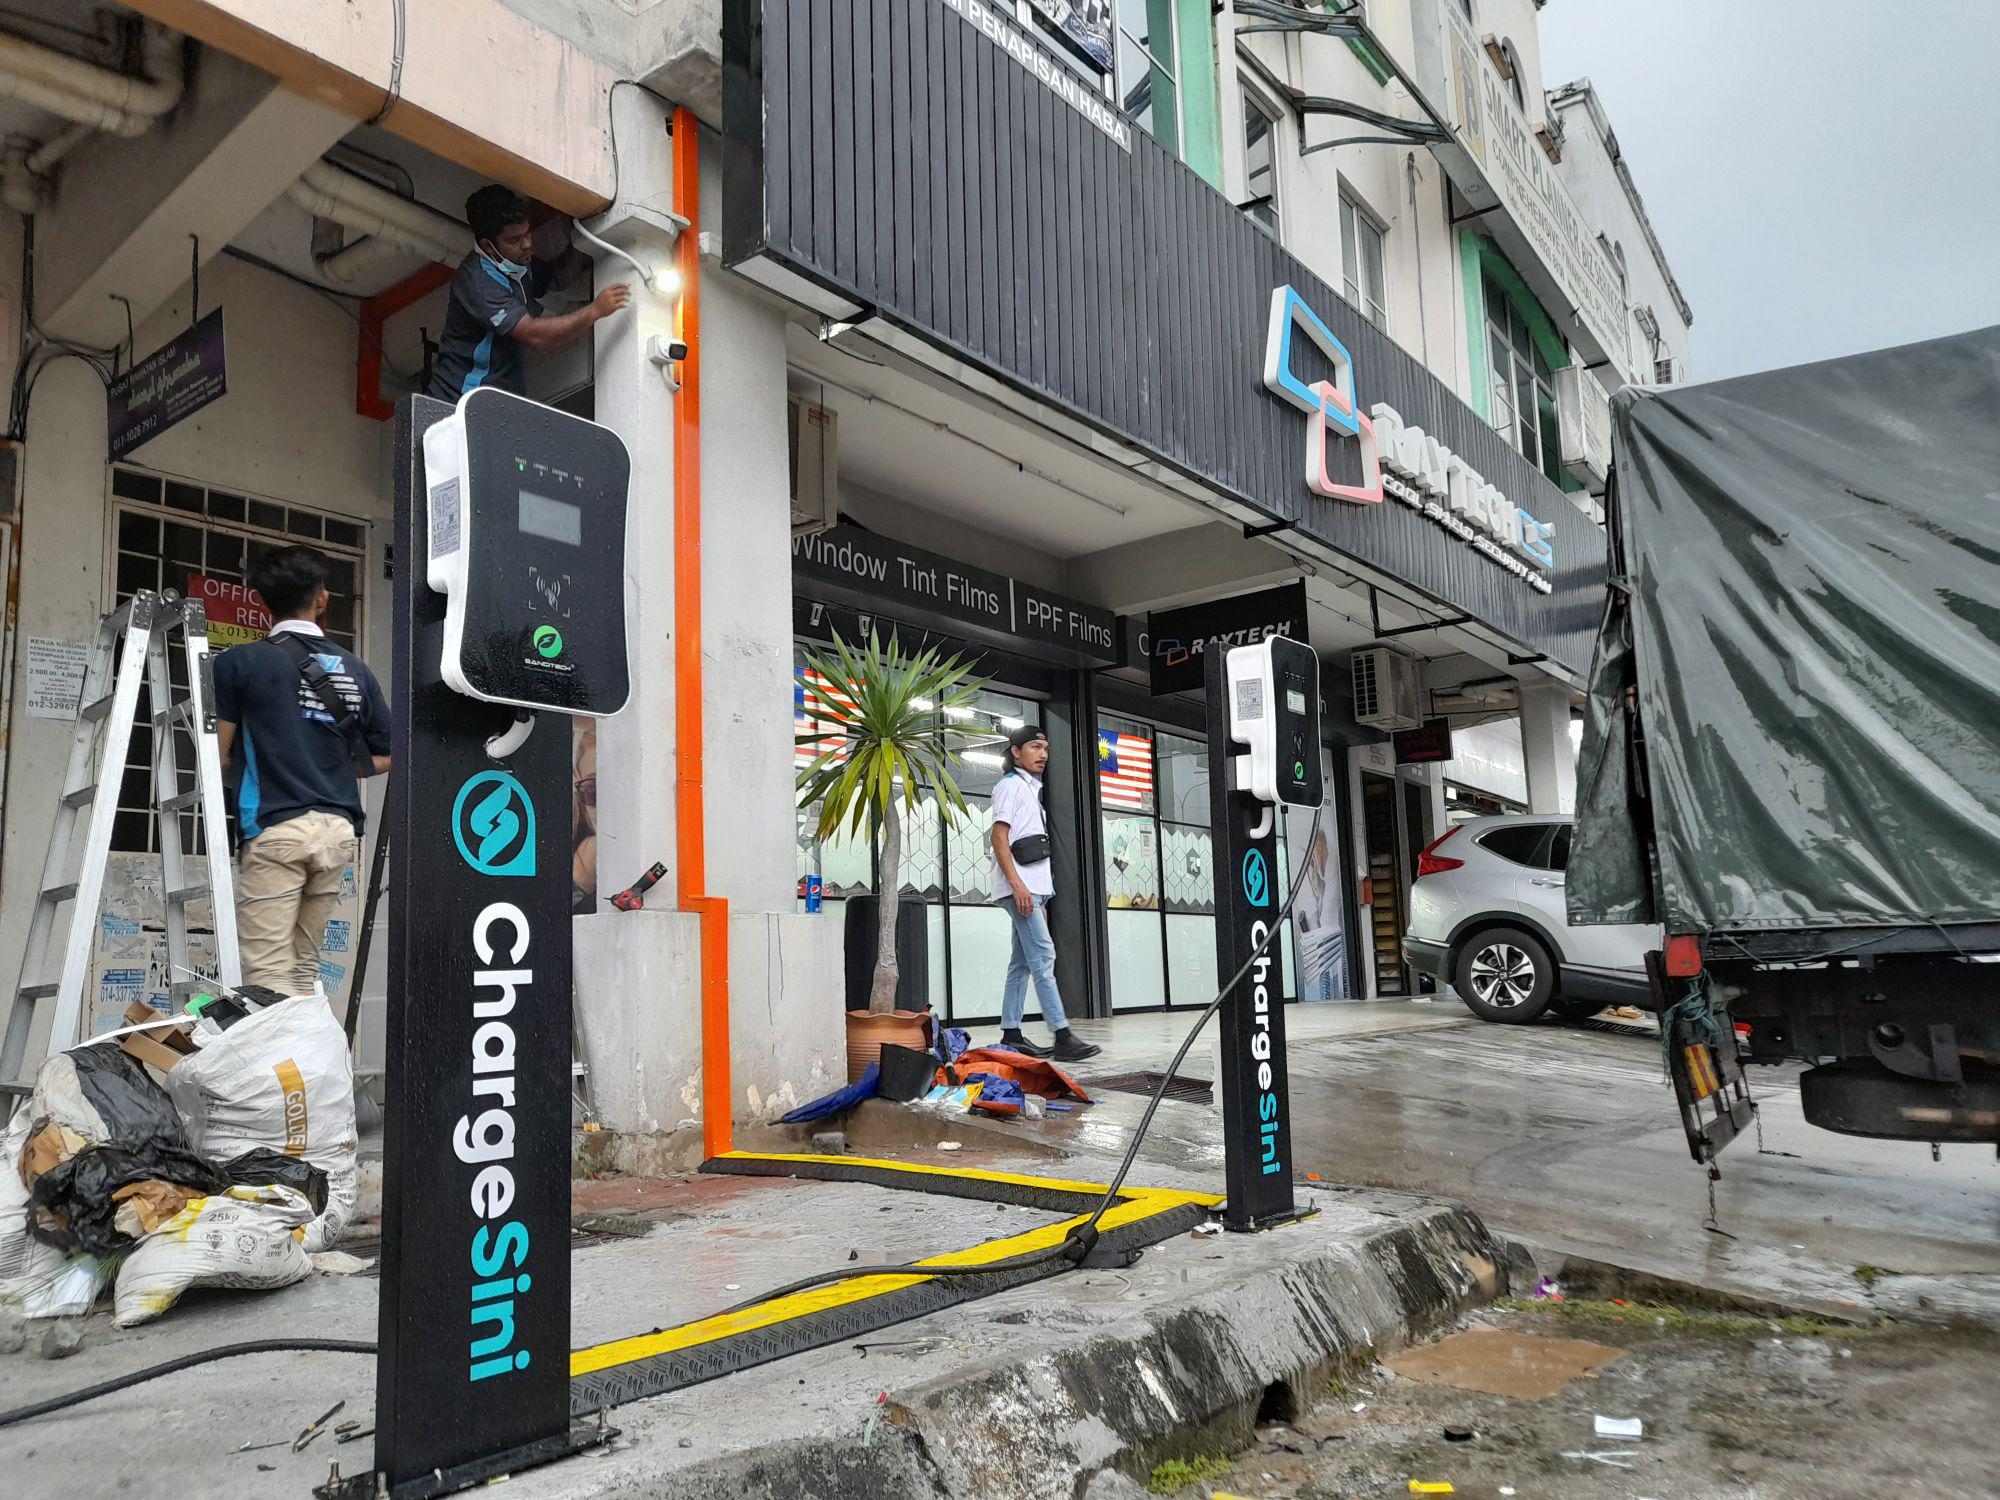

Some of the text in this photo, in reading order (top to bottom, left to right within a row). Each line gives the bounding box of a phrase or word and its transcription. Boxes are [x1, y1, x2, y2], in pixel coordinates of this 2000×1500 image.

[968, 0, 1074, 103] PENAPISAN
[1079, 91, 1125, 145] HABA
[1484, 67, 1527, 172] SMART
[1371, 402, 1519, 546] RAYTECH
[1381, 473, 1424, 510] COOL
[203, 578, 260, 607] OFFIC
[792, 533, 888, 582] Window
[896, 556, 938, 597] Tint
[946, 572, 1000, 615] Films
[1026, 597, 1064, 633] PPF
[1069, 611, 1112, 649] Films
[227, 626, 249, 639] 013
[236, 606, 273, 631] REN
[30, 638, 54, 647] KERJA
[1190, 620, 1291, 655] RAYTECH
[286, 1090, 308, 1146] GOLDE
[208, 1212, 240, 1223] 25kg
